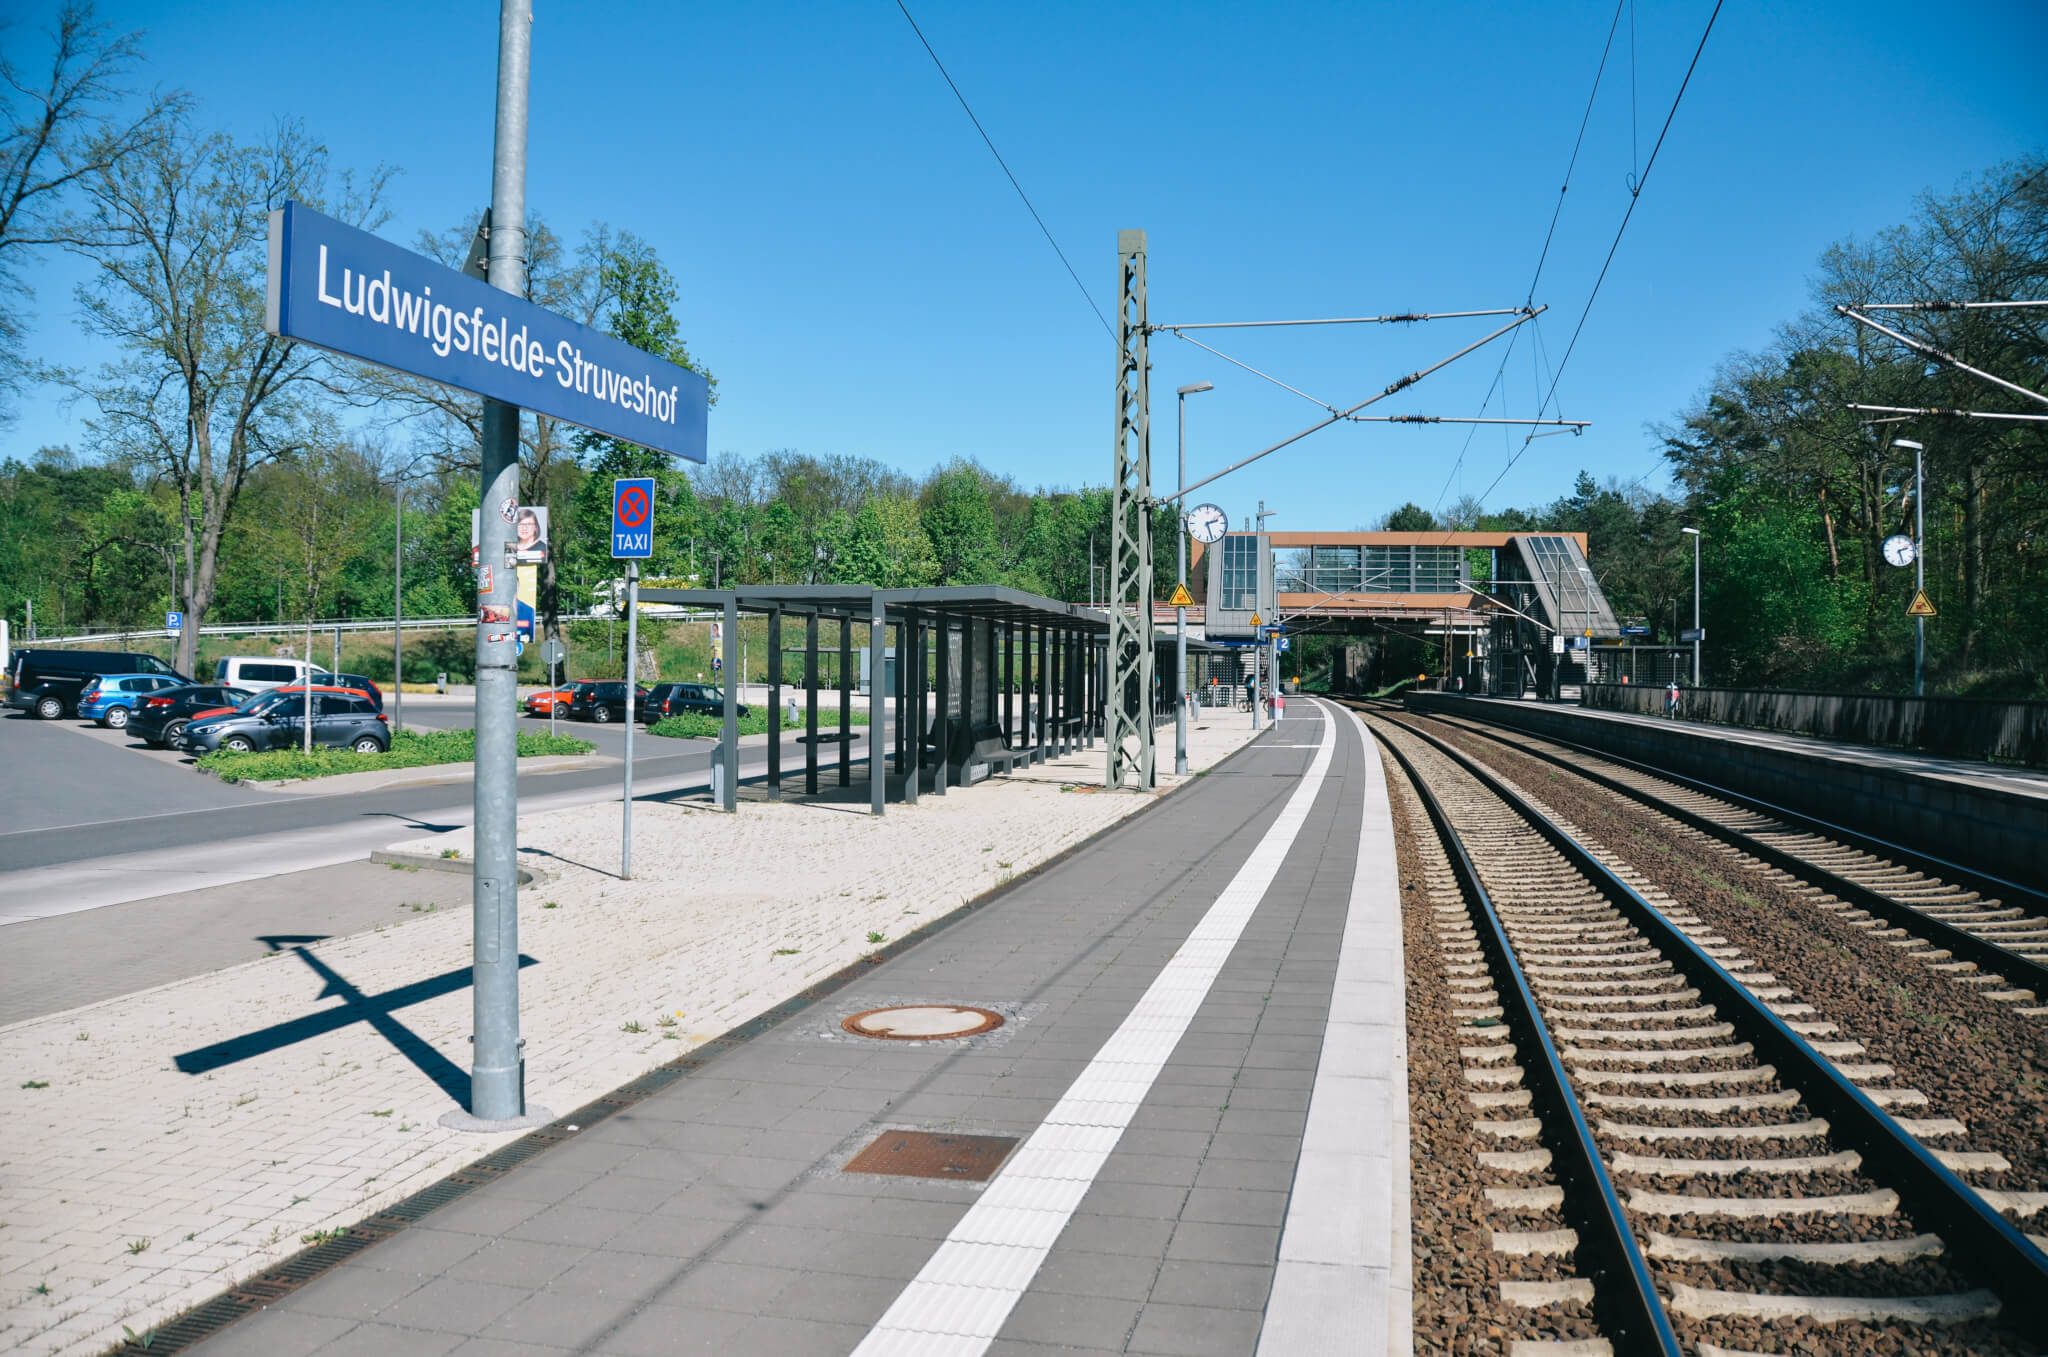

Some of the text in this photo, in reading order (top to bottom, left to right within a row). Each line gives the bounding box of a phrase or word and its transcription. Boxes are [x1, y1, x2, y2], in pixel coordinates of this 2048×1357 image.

[318, 244, 678, 425] Ludwigsfelde-Struveshof
[616, 534, 648, 550] TAXI
[169, 614, 178, 626] P
[1281, 638, 1289, 649] 2
